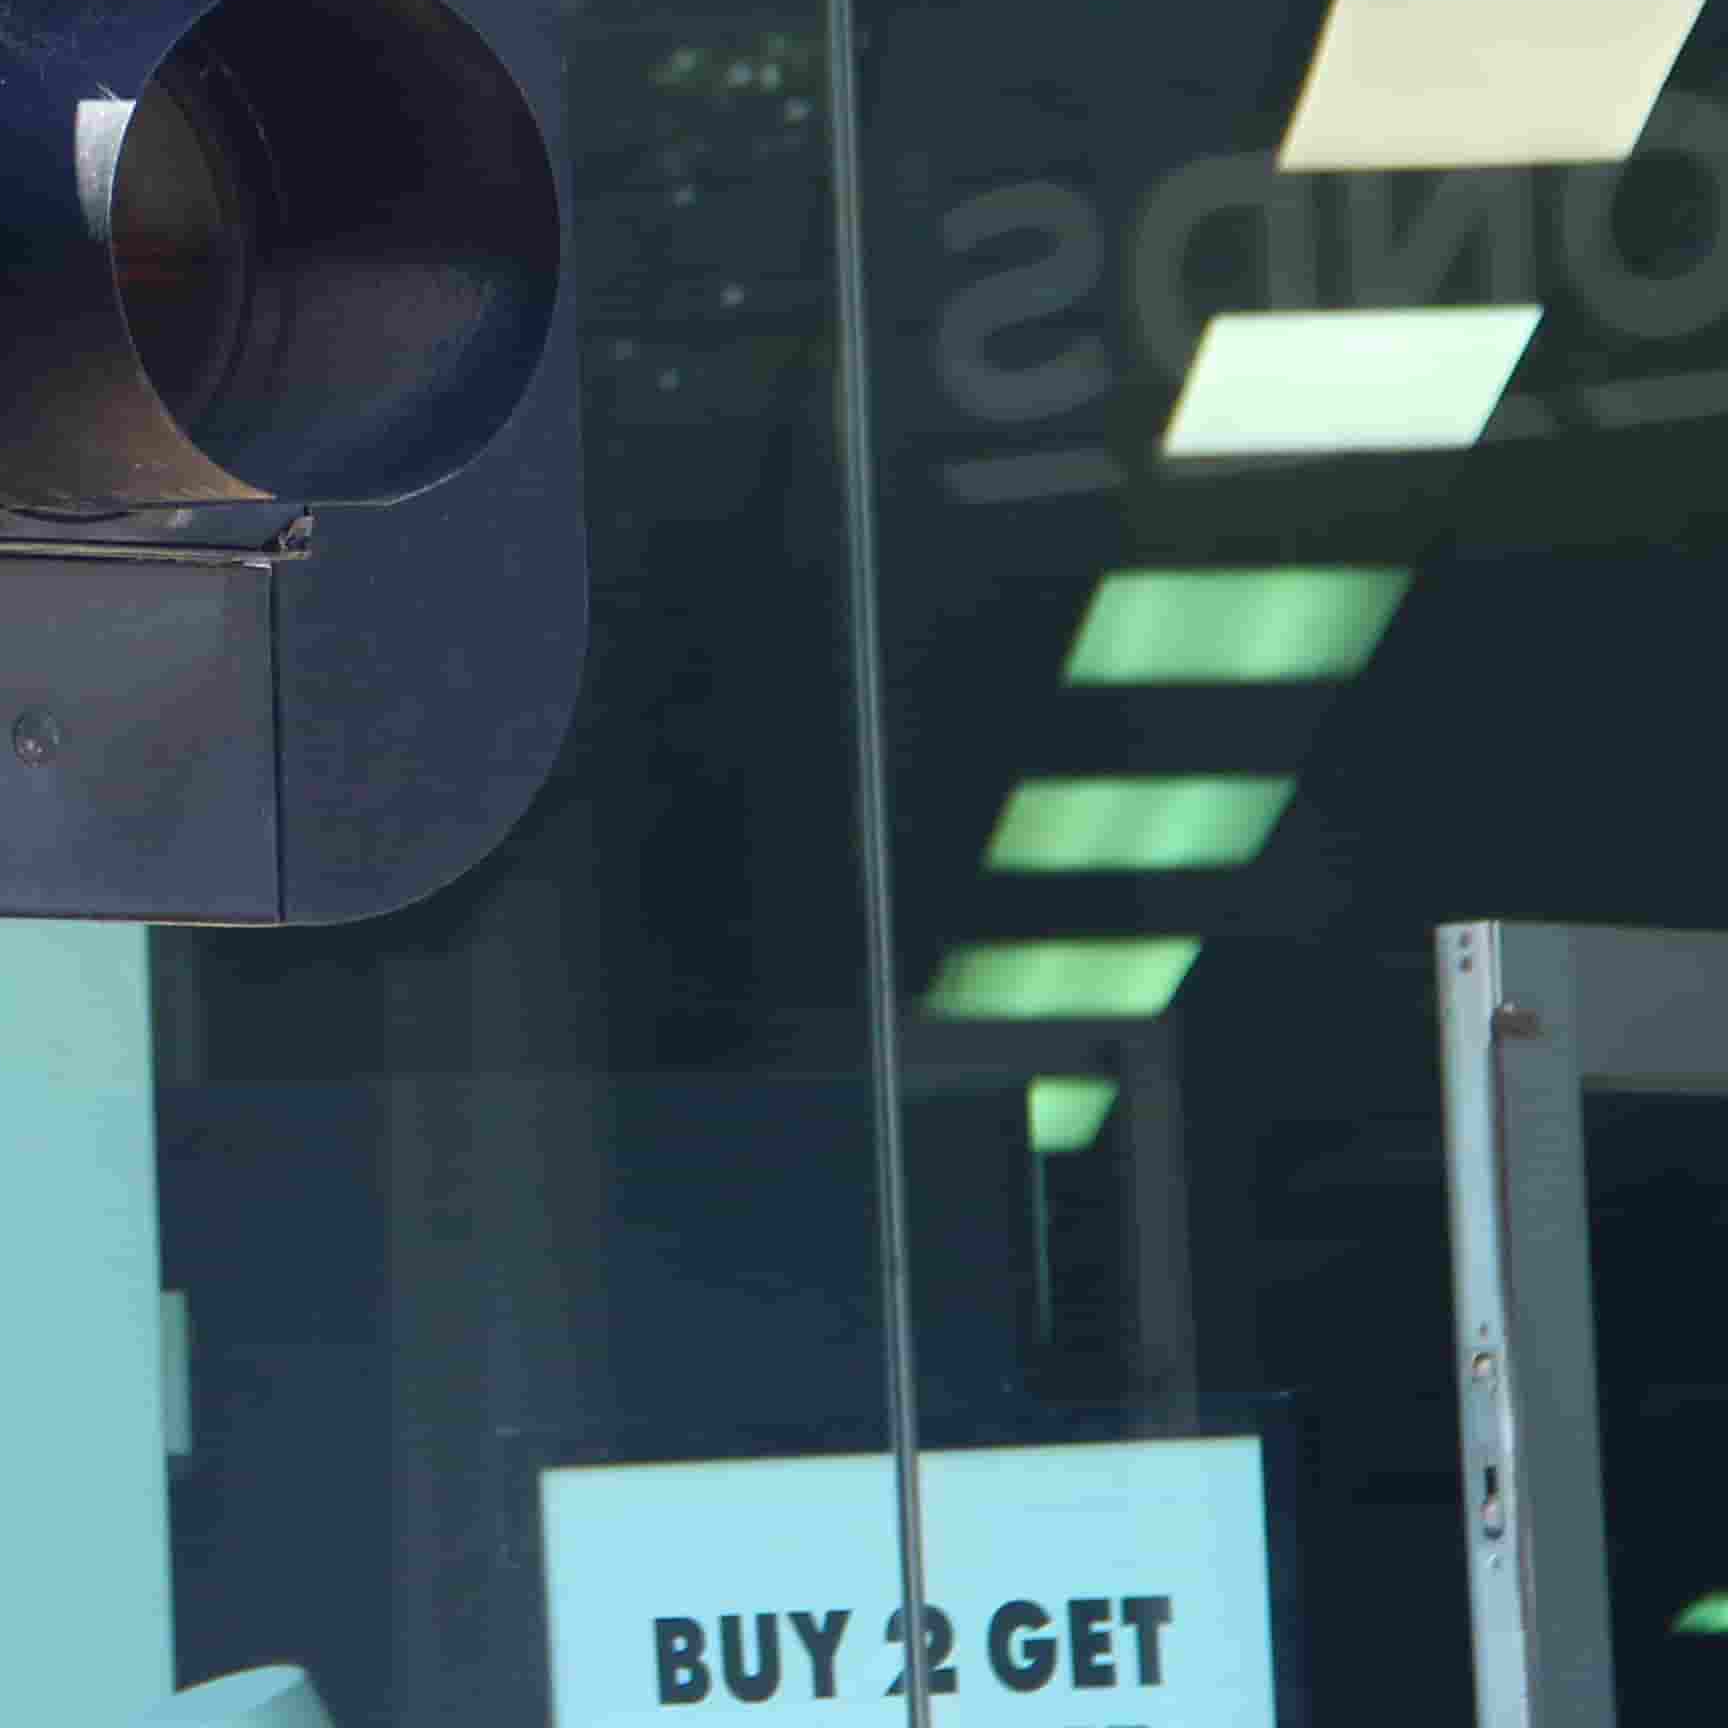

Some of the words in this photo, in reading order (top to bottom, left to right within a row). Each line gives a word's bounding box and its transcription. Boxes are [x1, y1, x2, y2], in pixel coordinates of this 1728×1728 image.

[653, 1610, 852, 1706] BUY
[885, 1605, 959, 1697] 2
[986, 1596, 1173, 1694] GET
